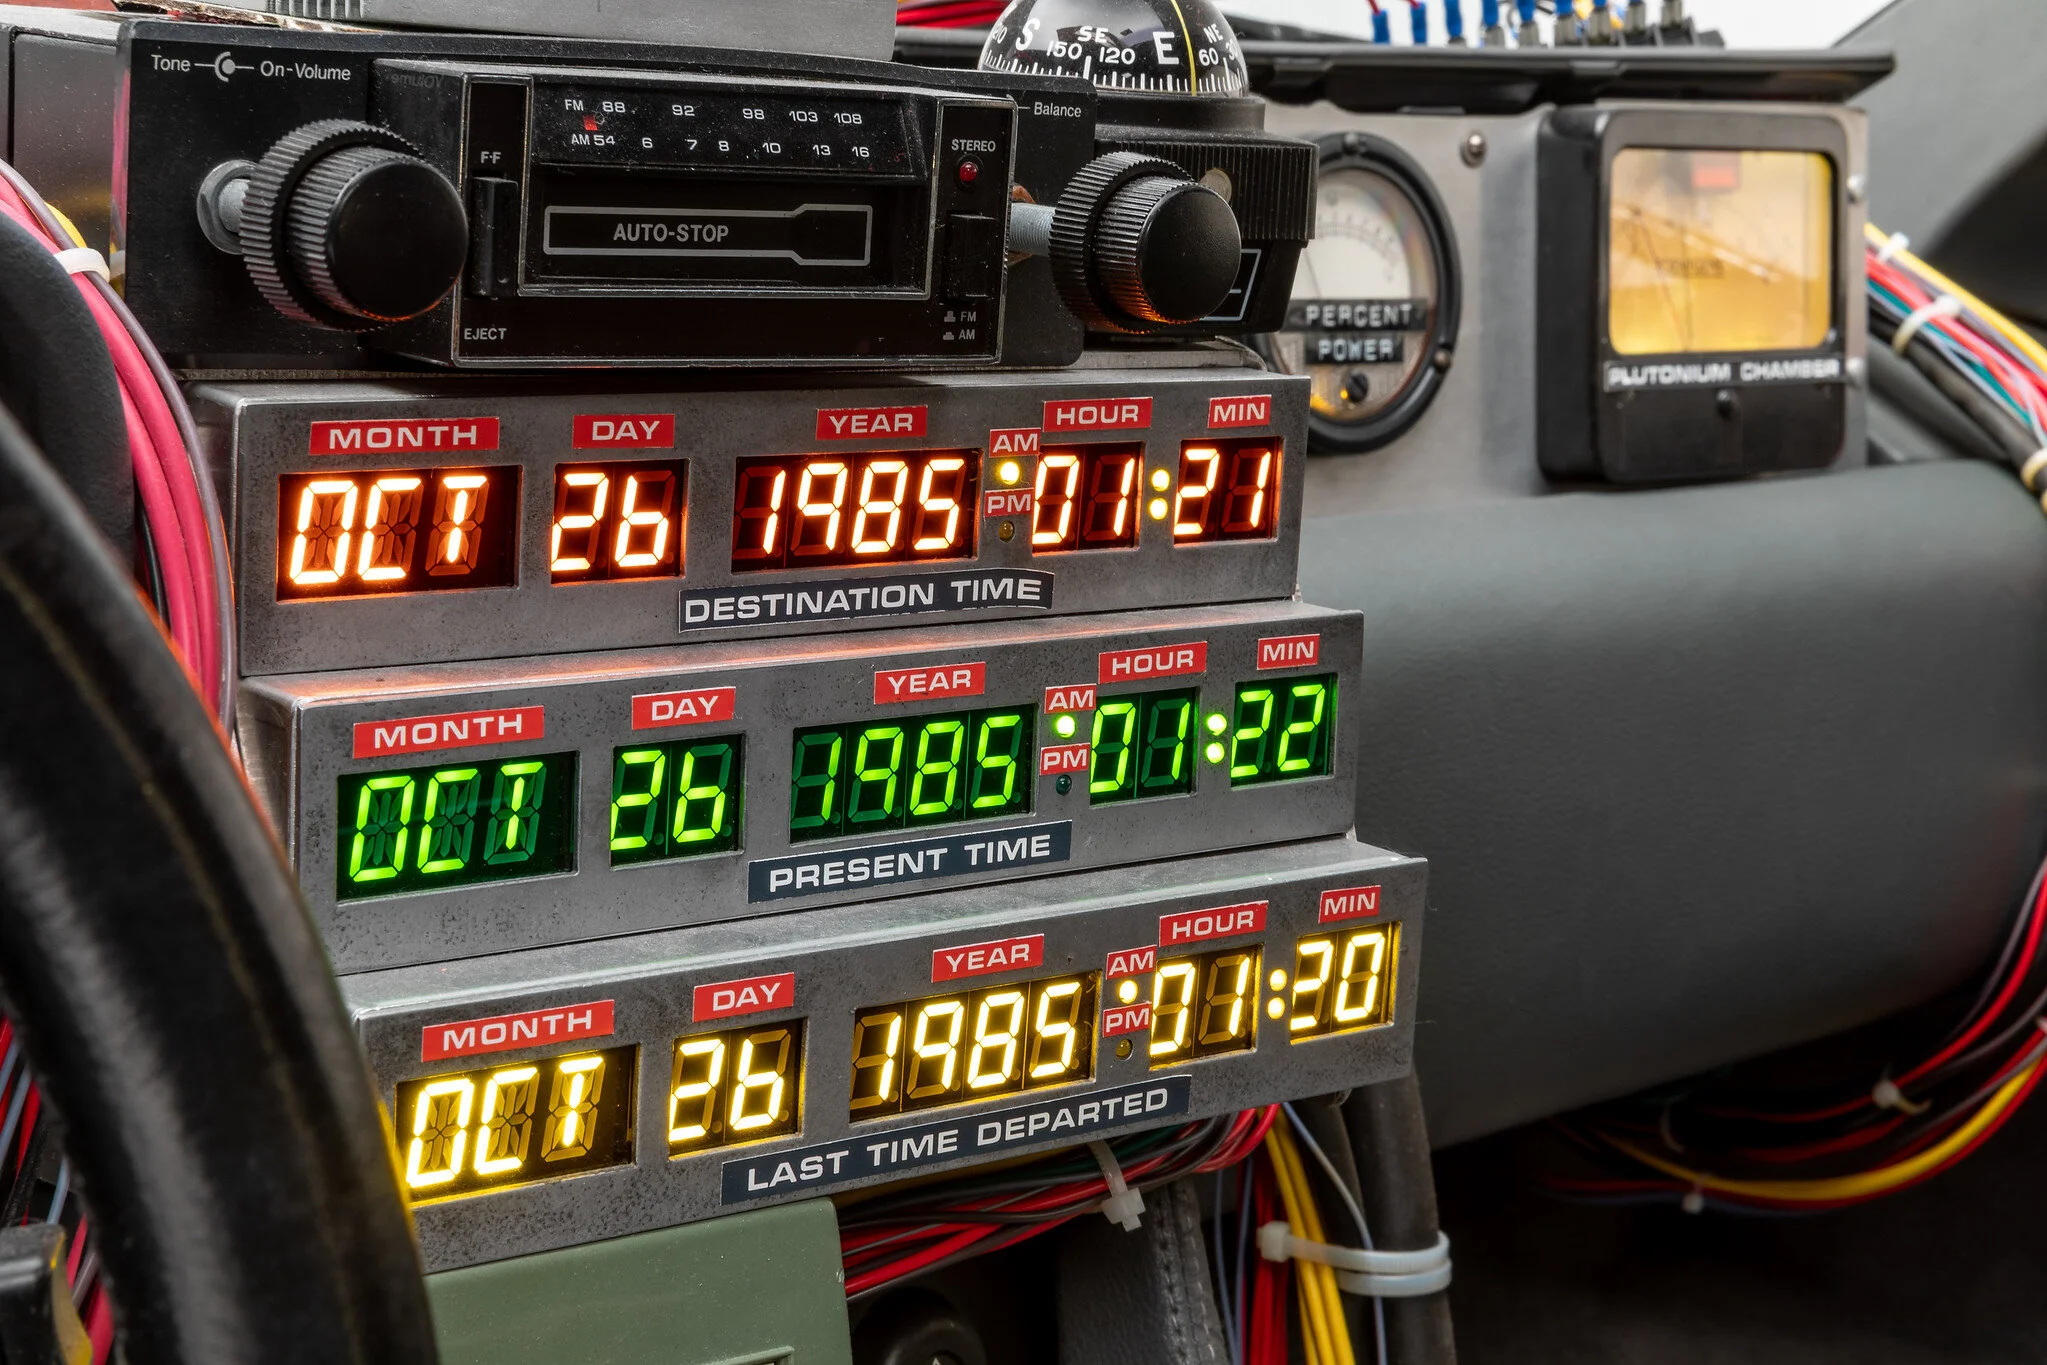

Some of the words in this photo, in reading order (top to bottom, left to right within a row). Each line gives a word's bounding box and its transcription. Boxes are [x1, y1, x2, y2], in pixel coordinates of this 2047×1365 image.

[1015, 18, 1040, 51] S
[1077, 25, 1109, 43] SE
[1203, 23, 1223, 43] NE
[1046, 40, 1083, 60] 150
[1099, 46, 1136, 65] 120
[1152, 31, 1180, 65] E
[1198, 47, 1218, 66] 60
[152, 54, 191, 72] Tone
[260, 61, 351, 81] On-Volume
[565, 99, 584, 111] FM
[602, 101, 626, 113] 88
[672, 105, 695, 117] 92
[742, 108, 765, 120] 98
[789, 111, 818, 122] 103
[834, 113, 862, 125] 108
[1033, 102, 1082, 118] Balance
[571, 134, 590, 146] AM
[594, 134, 615, 146] 54
[642, 137, 653, 149] 6
[687, 139, 698, 151] 7
[718, 140, 730, 152] 8
[762, 142, 781, 154] 10
[812, 144, 831, 156] 13
[852, 146, 870, 158] 16
[951, 138, 996, 152] STEREO
[613, 223, 729, 243] AUTO-STOP
[960, 311, 977, 322] FM
[1305, 303, 1413, 328] PERCENT
[463, 327, 507, 341] EJECT
[958, 329, 976, 340] AM
[1318, 339, 1394, 361] POWER
[1608, 361, 1731, 386] PLUTONIUM
[1740, 358, 1840, 381] CHAMBER
[828, 412, 914, 435] YEAR
[1056, 402, 1140, 425] HOUR
[1213, 401, 1267, 423] MIN
[328, 424, 478, 451] MONTH
[591, 420, 661, 441] DAY
[992, 433, 1038, 454] AM
[762, 457, 966, 556] 1985
[987, 491, 1032, 514] PM
[289, 475, 488, 585] OCT
[551, 472, 670, 572] 26
[685, 581, 935, 623] DESTINATION
[950, 577, 1042, 604] TIME
[1111, 650, 1194, 676] HOUR
[1262, 641, 1315, 662] MIN
[887, 670, 972, 695] YEAR
[651, 695, 719, 722] DAY
[1049, 690, 1093, 710] AM
[374, 713, 523, 749] MONTH
[821, 715, 1021, 823] 1985
[1043, 748, 1088, 770] PM
[610, 749, 726, 851] 26
[349, 761, 545, 883] OCT
[769, 848, 948, 893] PRESENT
[964, 835, 1051, 866] TIME
[1325, 892, 1376, 914] MIN
[1171, 910, 1255, 938] HOUR
[946, 942, 1030, 972] YEAR
[1108, 951, 1153, 975] AM
[712, 983, 781, 1012] DAY
[443, 1010, 593, 1051] MONTH
[1105, 1009, 1149, 1033] PM
[880, 982, 1080, 1101] 1985
[668, 1038, 784, 1143] 26
[405, 1055, 603, 1188] OCT
[747, 1150, 849, 1191] LAST
[867, 1130, 958, 1167] TIME
[978, 1088, 1168, 1144] DEPARTED
